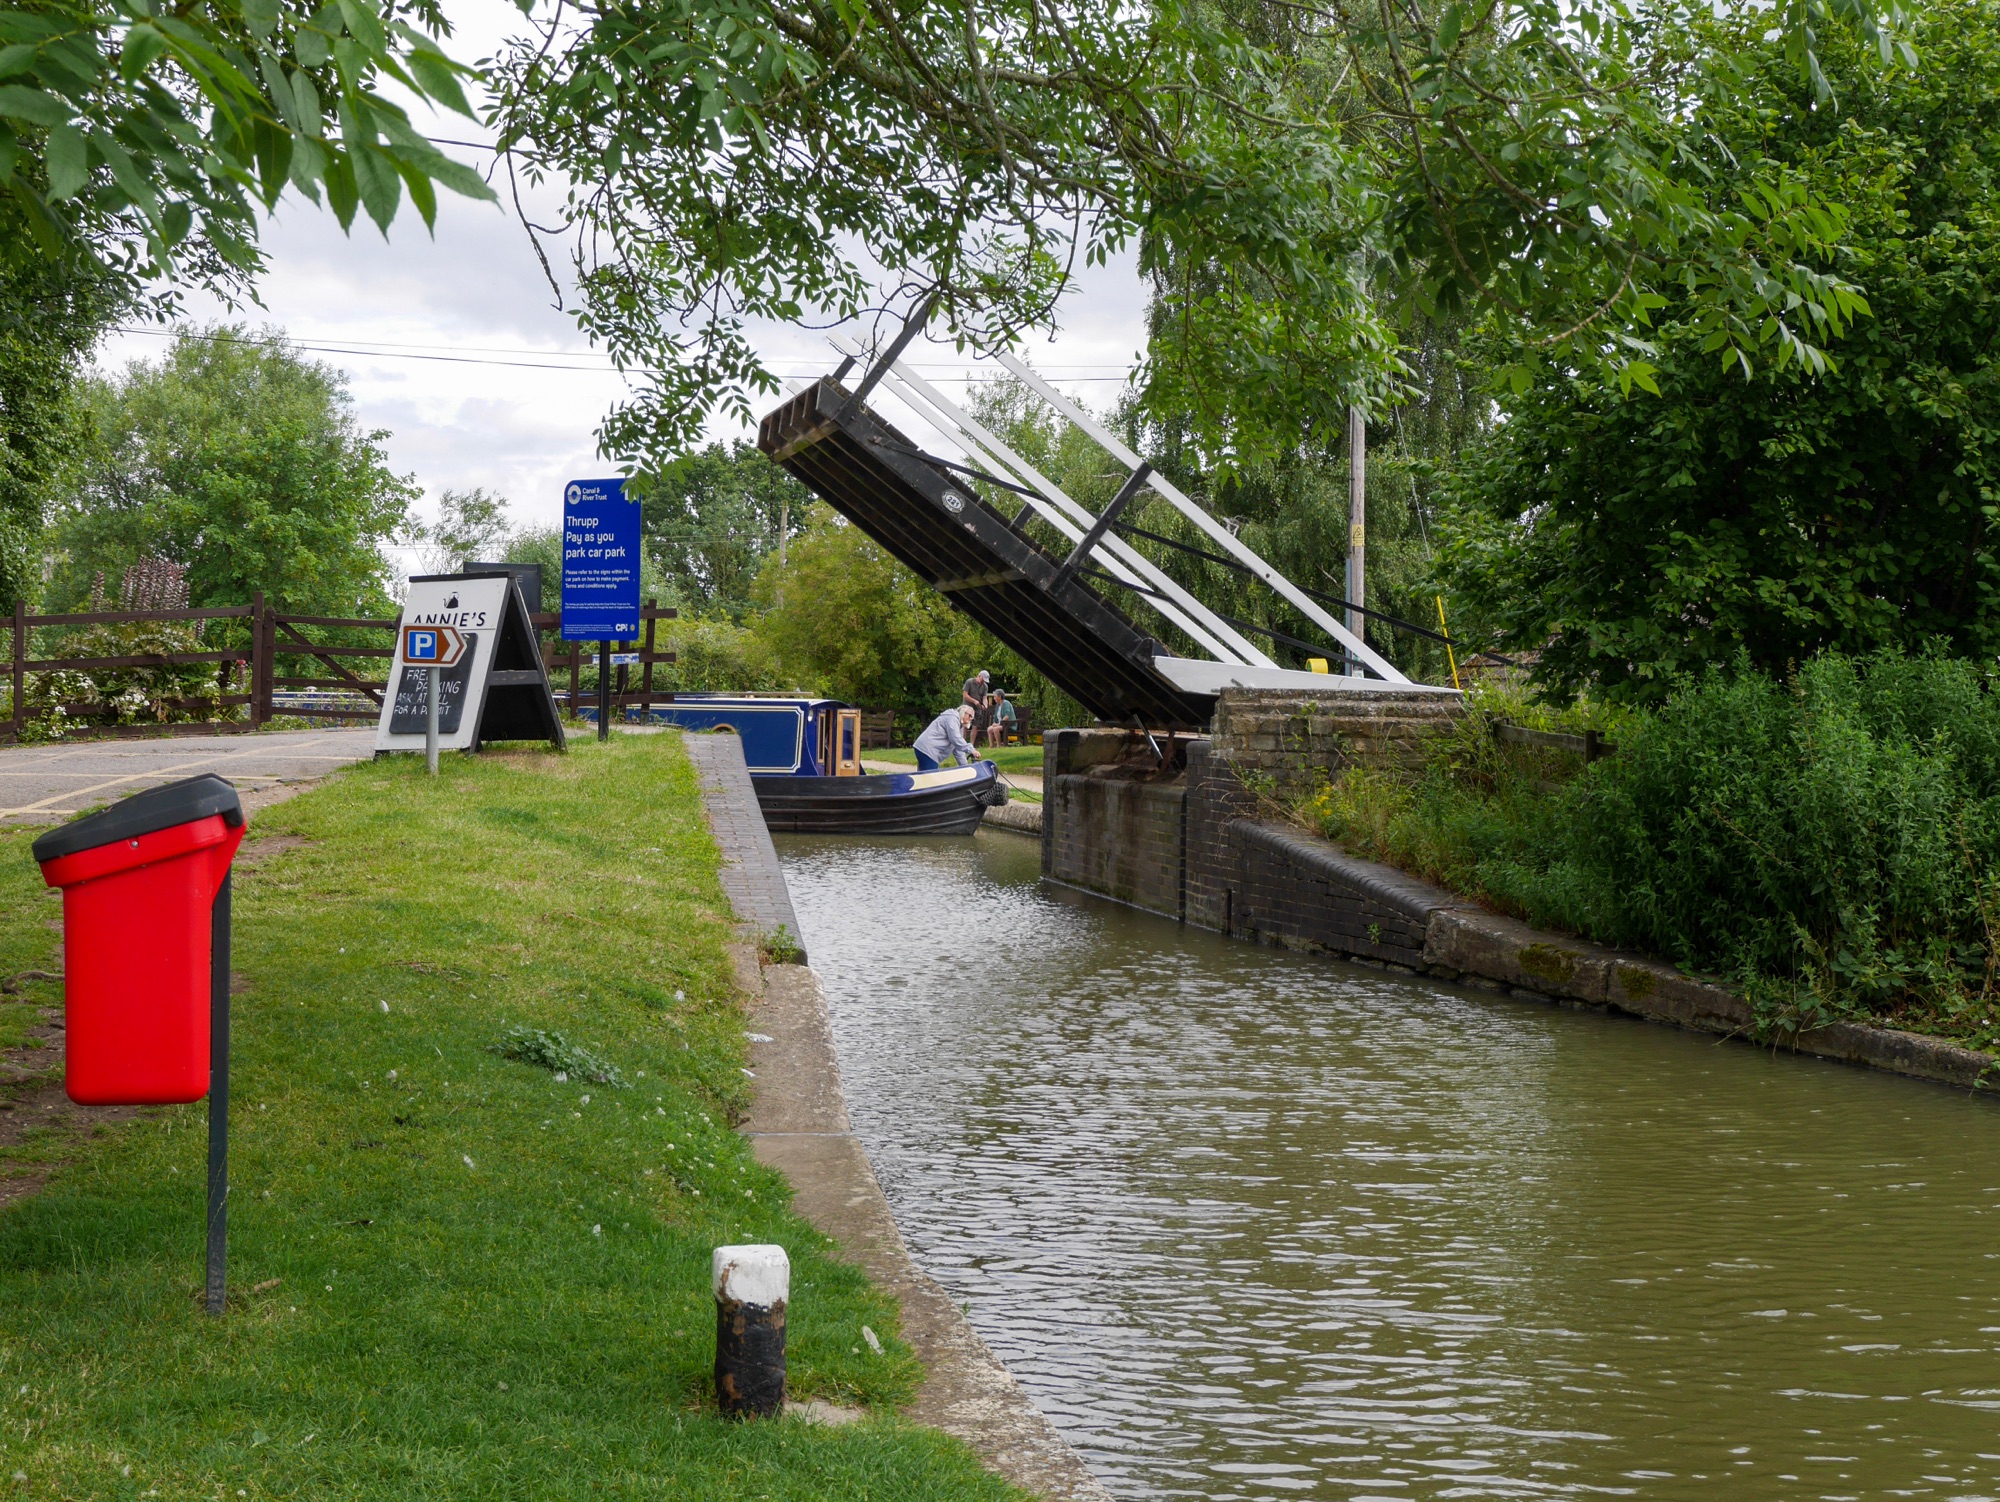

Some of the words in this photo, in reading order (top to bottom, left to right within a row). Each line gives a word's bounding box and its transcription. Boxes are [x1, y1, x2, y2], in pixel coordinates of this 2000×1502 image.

[947, 497, 959, 508] 221
[567, 516, 598, 528] Thrupp
[566, 532, 582, 545] Pay
[597, 533, 614, 544] you
[566, 547, 586, 560] park
[588, 549, 603, 557] car
[605, 546, 626, 560] park
[414, 612, 486, 626] ANNIE'S
[415, 634, 432, 656] P
[407, 669, 428, 680] FRE
[394, 705, 408, 714] FOR
[411, 706, 416, 714] A
